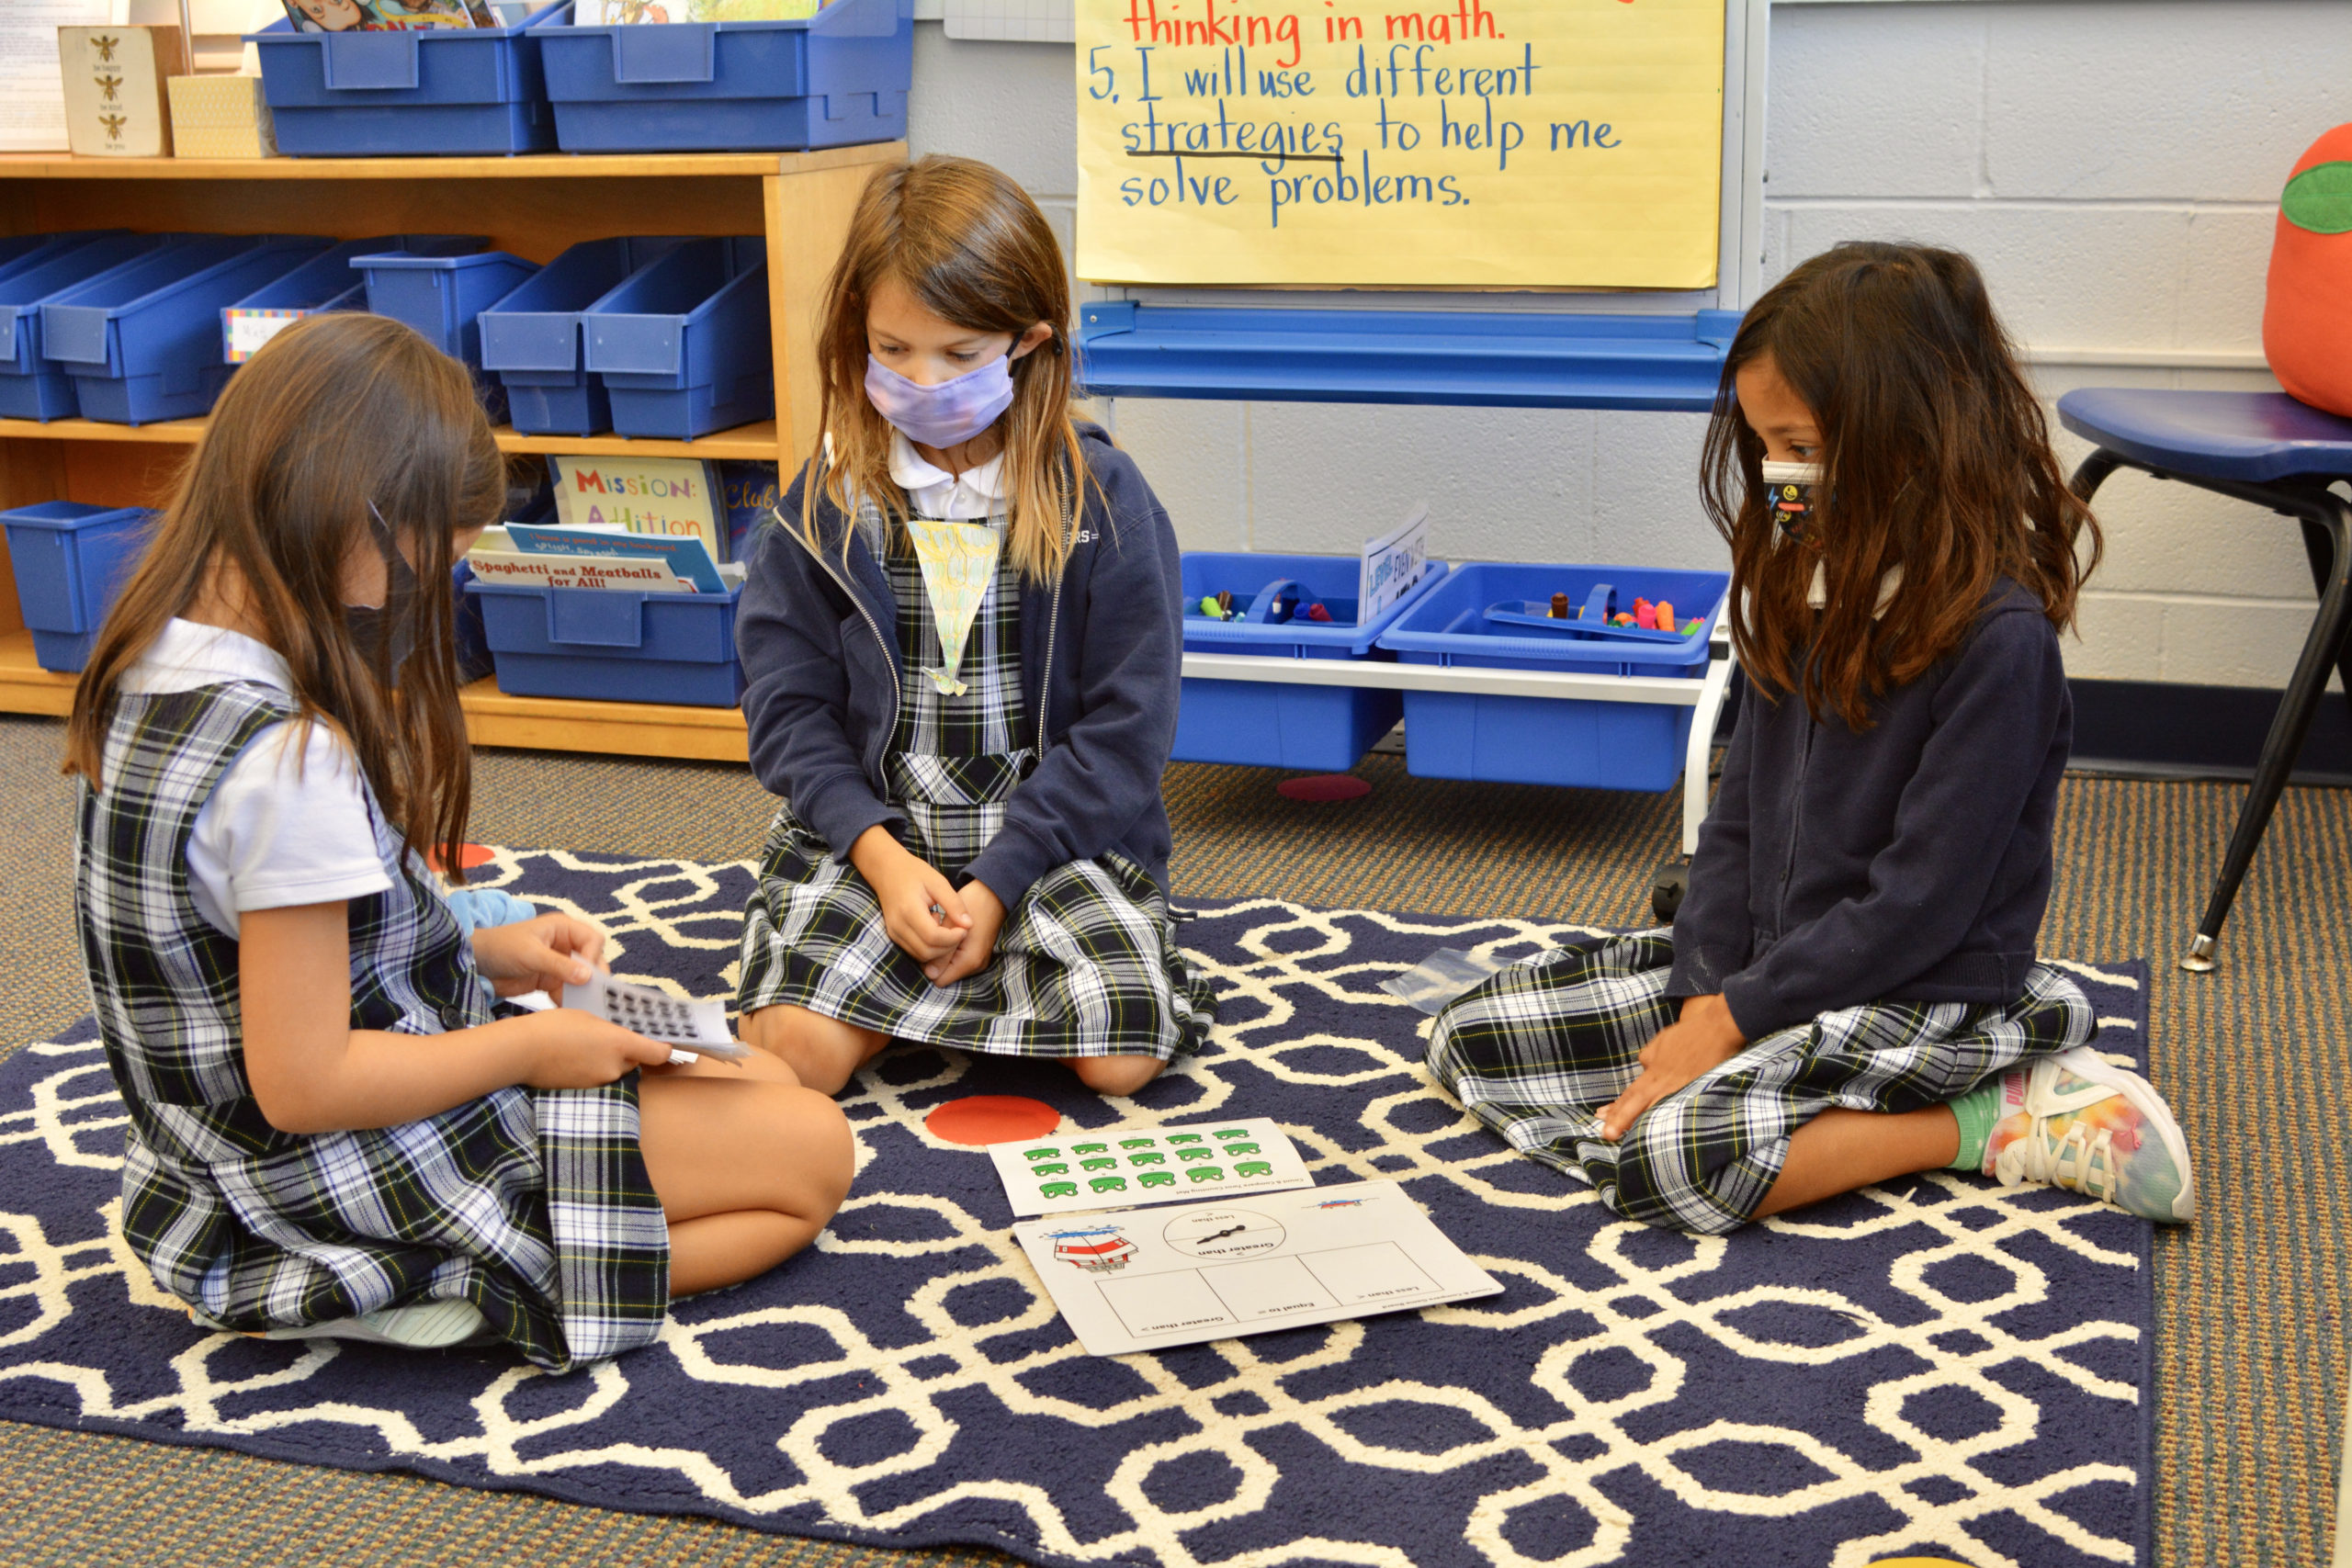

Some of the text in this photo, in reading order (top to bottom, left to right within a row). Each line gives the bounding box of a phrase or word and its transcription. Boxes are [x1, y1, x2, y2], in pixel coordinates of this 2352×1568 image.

[1123, 0, 1506, 69] thinking in math.
[1089, 43, 1543, 104] 5. I will use different
[1121, 96, 1623, 175] strategies to help me
[1119, 149, 1470, 228] solve problems.
[727, 480, 775, 510] Club
[472, 559, 662, 580] Spaghetti and Meatballs
[548, 576, 606, 589] for All!
[1198, 1242, 1274, 1257] Greater than
[1367, 1290, 1395, 1299] than
[1283, 1302, 1316, 1311] Equal
[1151, 1323, 1178, 1331] than
[1182, 1316, 1225, 1326] Greater
